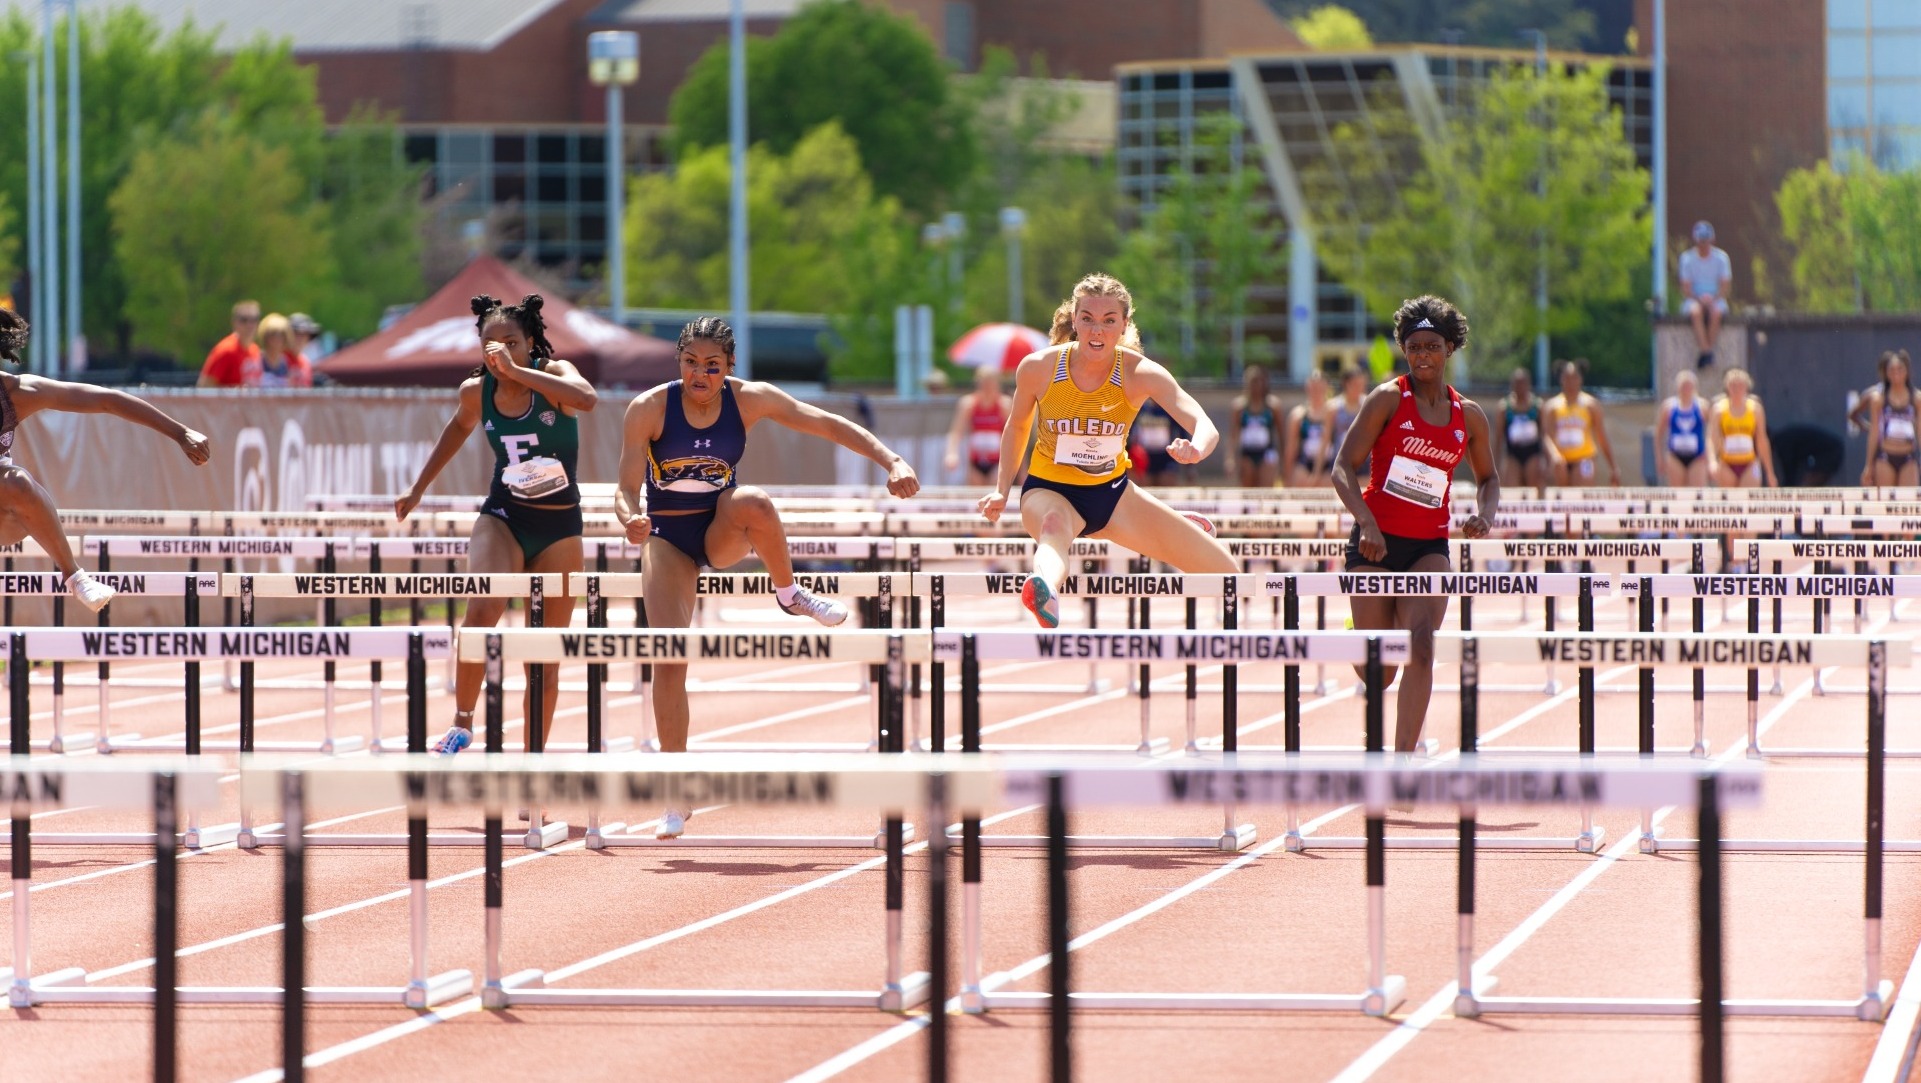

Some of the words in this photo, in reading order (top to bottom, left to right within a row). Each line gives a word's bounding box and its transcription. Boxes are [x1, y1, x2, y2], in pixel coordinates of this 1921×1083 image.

[1046, 418, 1126, 436] TOLEDO
[1402, 436, 1462, 464] Miami
[1404, 475, 1433, 488] WALTERS
[1886, 506, 1921, 514] WESTE
[1619, 518, 1679, 528] WESTERN
[1685, 518, 1748, 529] MICHIGAN
[140, 541, 211, 554] WESTERN
[218, 541, 293, 554] MICHIGAN
[789, 542, 837, 555] HIGAN
[953, 543, 1026, 555] WESTERN
[1229, 543, 1302, 556] WESTERN
[1504, 543, 1578, 557] WESTERN
[1584, 543, 1662, 557] MICHIGAN
[1793, 543, 1866, 557] WESTERN
[1873, 544, 1921, 558] MICHI
[295, 577, 387, 594] WESTERN
[395, 577, 491, 594] MICHIGAN
[1087, 576, 1183, 595] MICHIGAN
[1339, 576, 1431, 594] WESTERN
[1441, 576, 1538, 594] MICHIGAN
[1694, 577, 1787, 596] WESTERN
[1796, 577, 1894, 596] MICHIGAN
[82, 632, 207, 656] WESTERN
[220, 632, 350, 656] MICHIGAN
[562, 635, 686, 658] WESTERN
[700, 635, 831, 658] MICHIGAN
[1036, 635, 1163, 658] WESTERN
[1177, 635, 1309, 658] MICHIGAN
[1538, 639, 1665, 663] WESTERN
[1679, 640, 1813, 663] MICHIGAN
[404, 770, 598, 803] WESTERN
[626, 771, 836, 804] MICHIGAN
[1166, 770, 1365, 803] WESTERN
[1390, 770, 1607, 803] MICHIGAN
